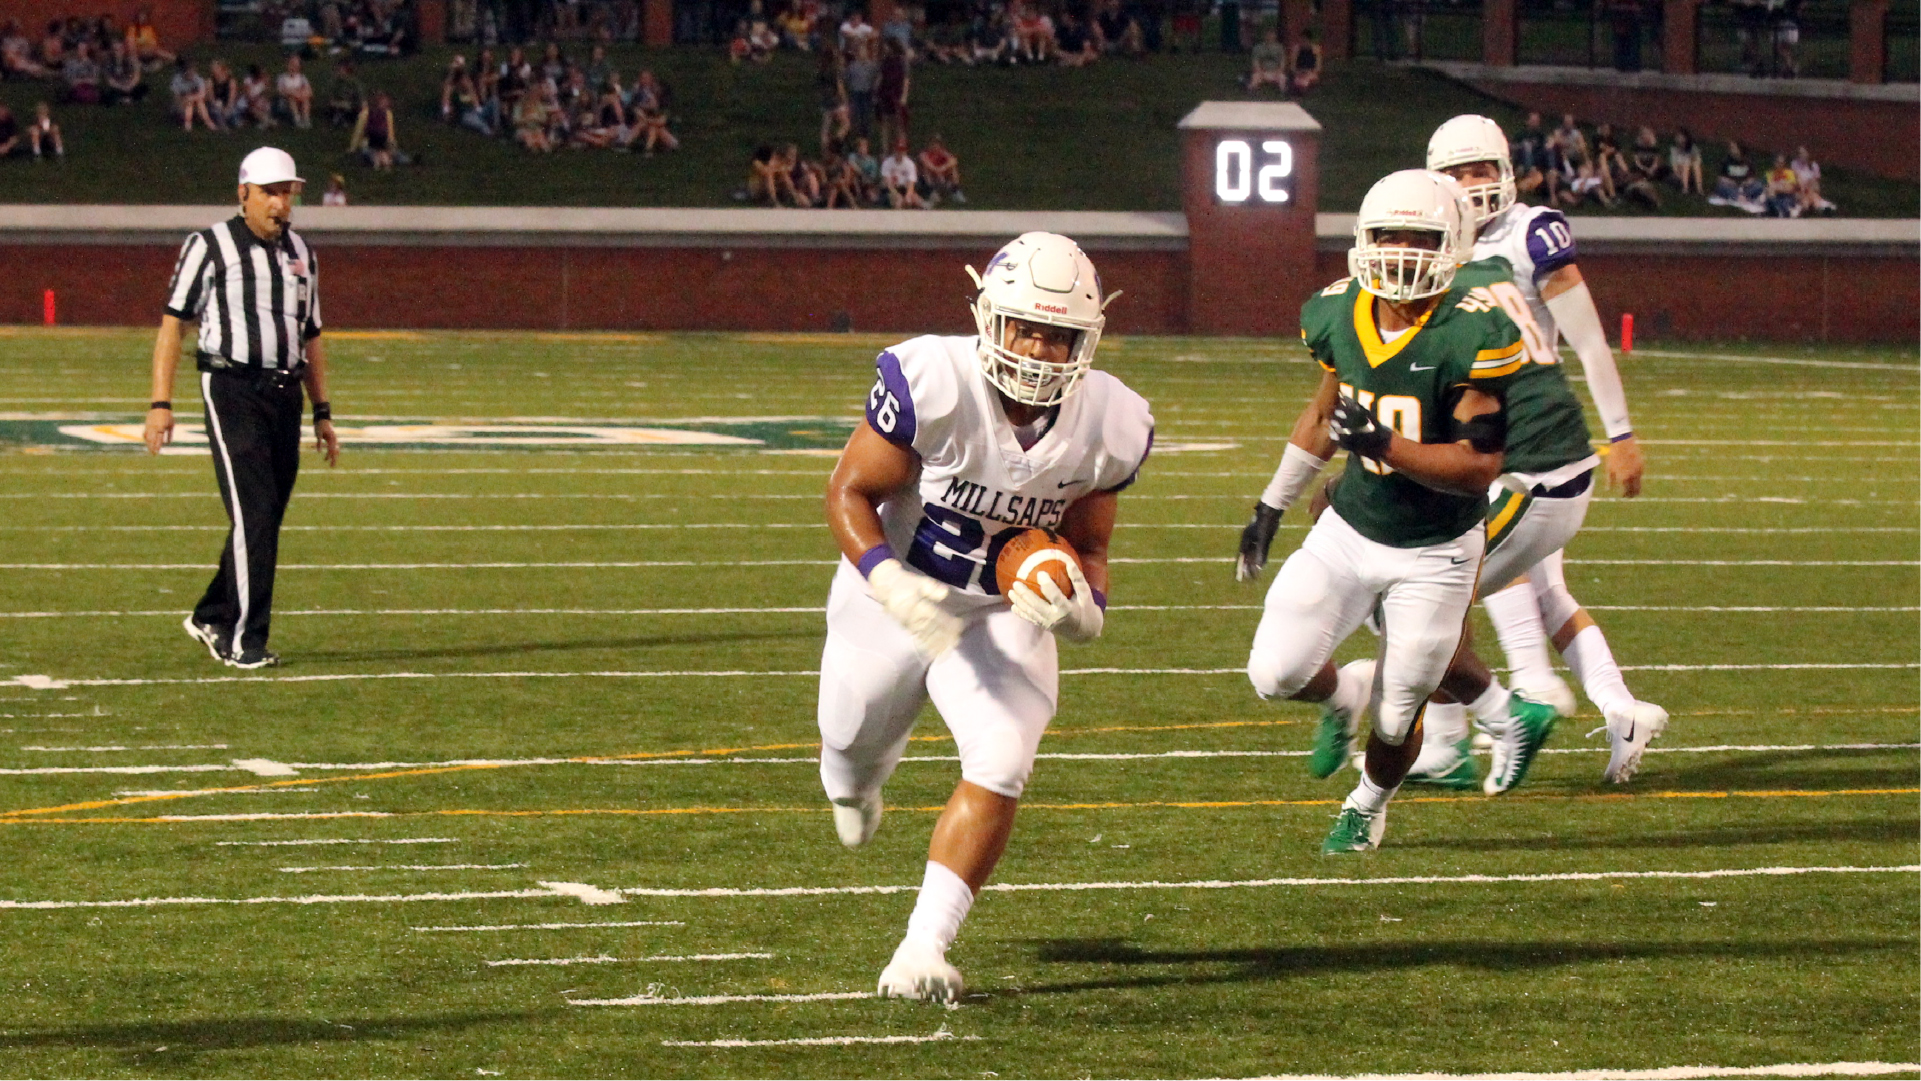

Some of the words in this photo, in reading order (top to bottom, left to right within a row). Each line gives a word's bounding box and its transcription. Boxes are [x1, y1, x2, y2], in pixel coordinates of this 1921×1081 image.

[1216, 140, 1291, 201] 02
[1534, 221, 1571, 256] 10
[1034, 303, 1067, 315] Riddell
[870, 367, 900, 433] 26
[940, 476, 1065, 527] MILLSAPS
